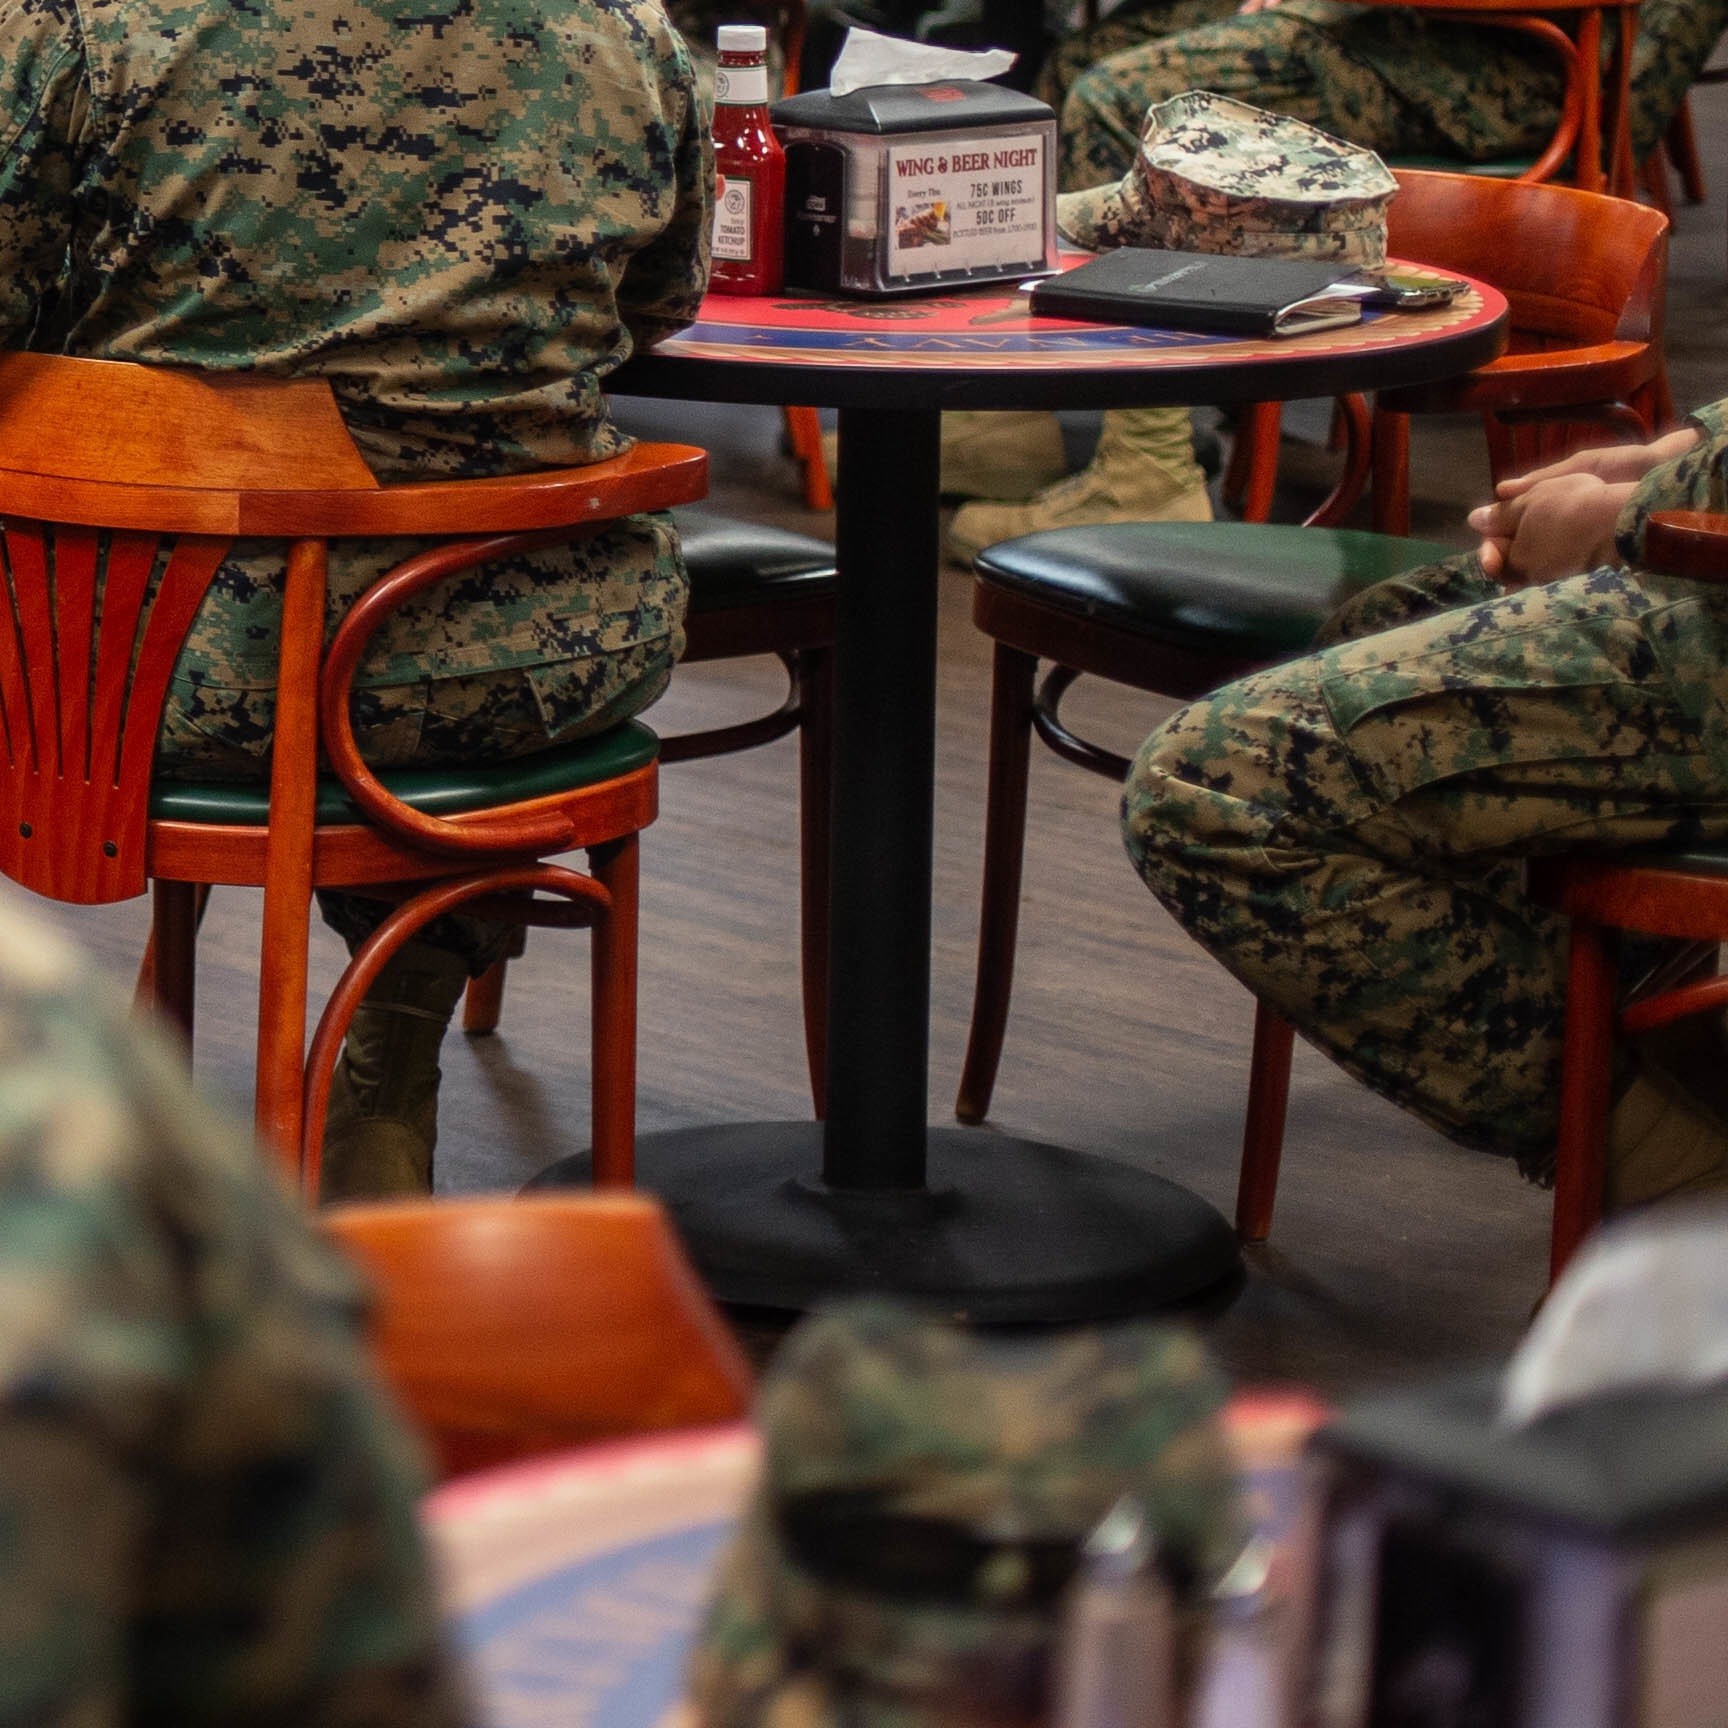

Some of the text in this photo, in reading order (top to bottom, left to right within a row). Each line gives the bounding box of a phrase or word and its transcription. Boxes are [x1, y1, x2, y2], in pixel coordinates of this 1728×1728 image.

[896, 148, 1037, 177] WING & BEER NIGHT
[992, 180, 1023, 196] WINGS
[998, 208, 1016, 223] OFF
[718, 235, 745, 245] KETCHUP
